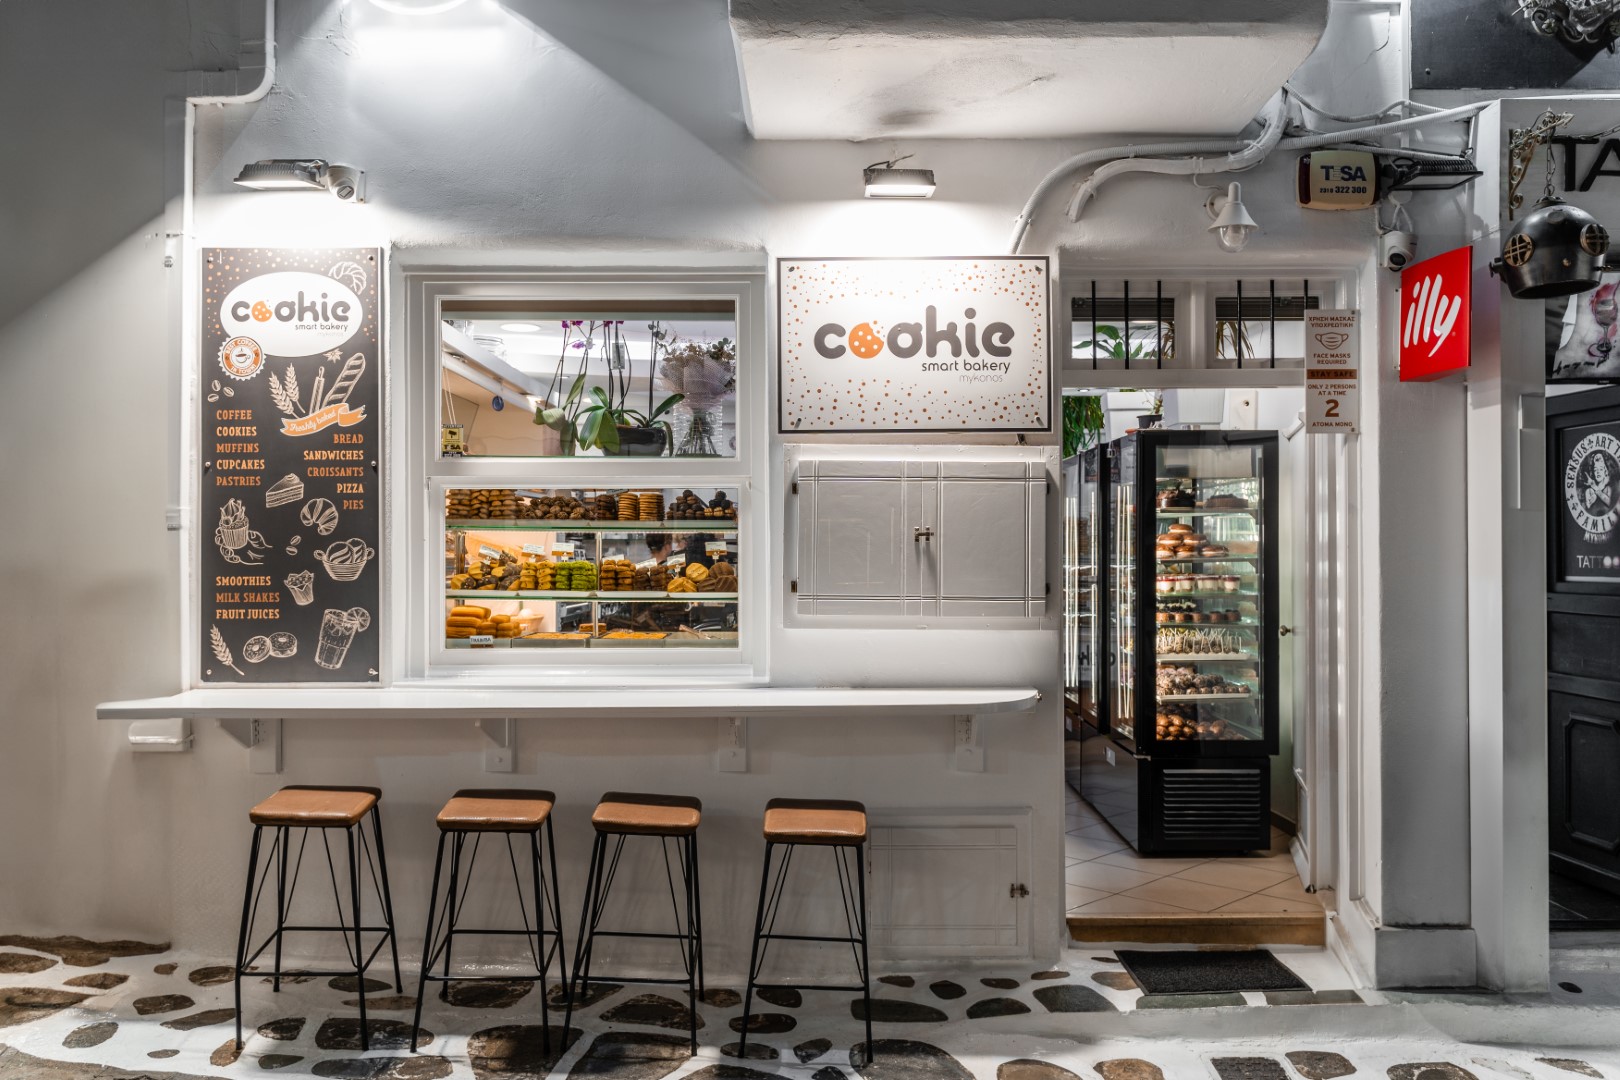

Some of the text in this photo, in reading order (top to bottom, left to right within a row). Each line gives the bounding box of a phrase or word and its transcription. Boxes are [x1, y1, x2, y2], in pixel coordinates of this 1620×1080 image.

[1335, 186, 1350, 194] 322
[1351, 186, 1367, 194] 300
[231, 290, 351, 322] cookie
[1403, 273, 1462, 358] illy
[320, 322, 349, 332] bakery
[813, 304, 1015, 360] cookie
[921, 358, 1011, 374] smart bakery
[959, 373, 1003, 384] mykonos
[1325, 399, 1340, 418] 2
[216, 409, 252, 420] COFFEE
[216, 426, 257, 437] COOKIES
[333, 434, 364, 444] BREAD
[216, 443, 259, 453] MUFFINS
[303, 450, 364, 460] SANDWICHES
[216, 459, 265, 470] CUPCAKES
[1567, 442, 1588, 489] SENSUS
[1595, 435, 1614, 450] ART
[307, 467, 364, 477] CROISSANTS
[216, 476, 261, 486] PASTRIES
[336, 483, 364, 494] PIZZA
[343, 499, 364, 510] PIES
[215, 576, 271, 586] SMOOTHIES
[215, 592, 280, 603] MILK SHAKES
[215, 609, 280, 620] FRUIT JUICES
